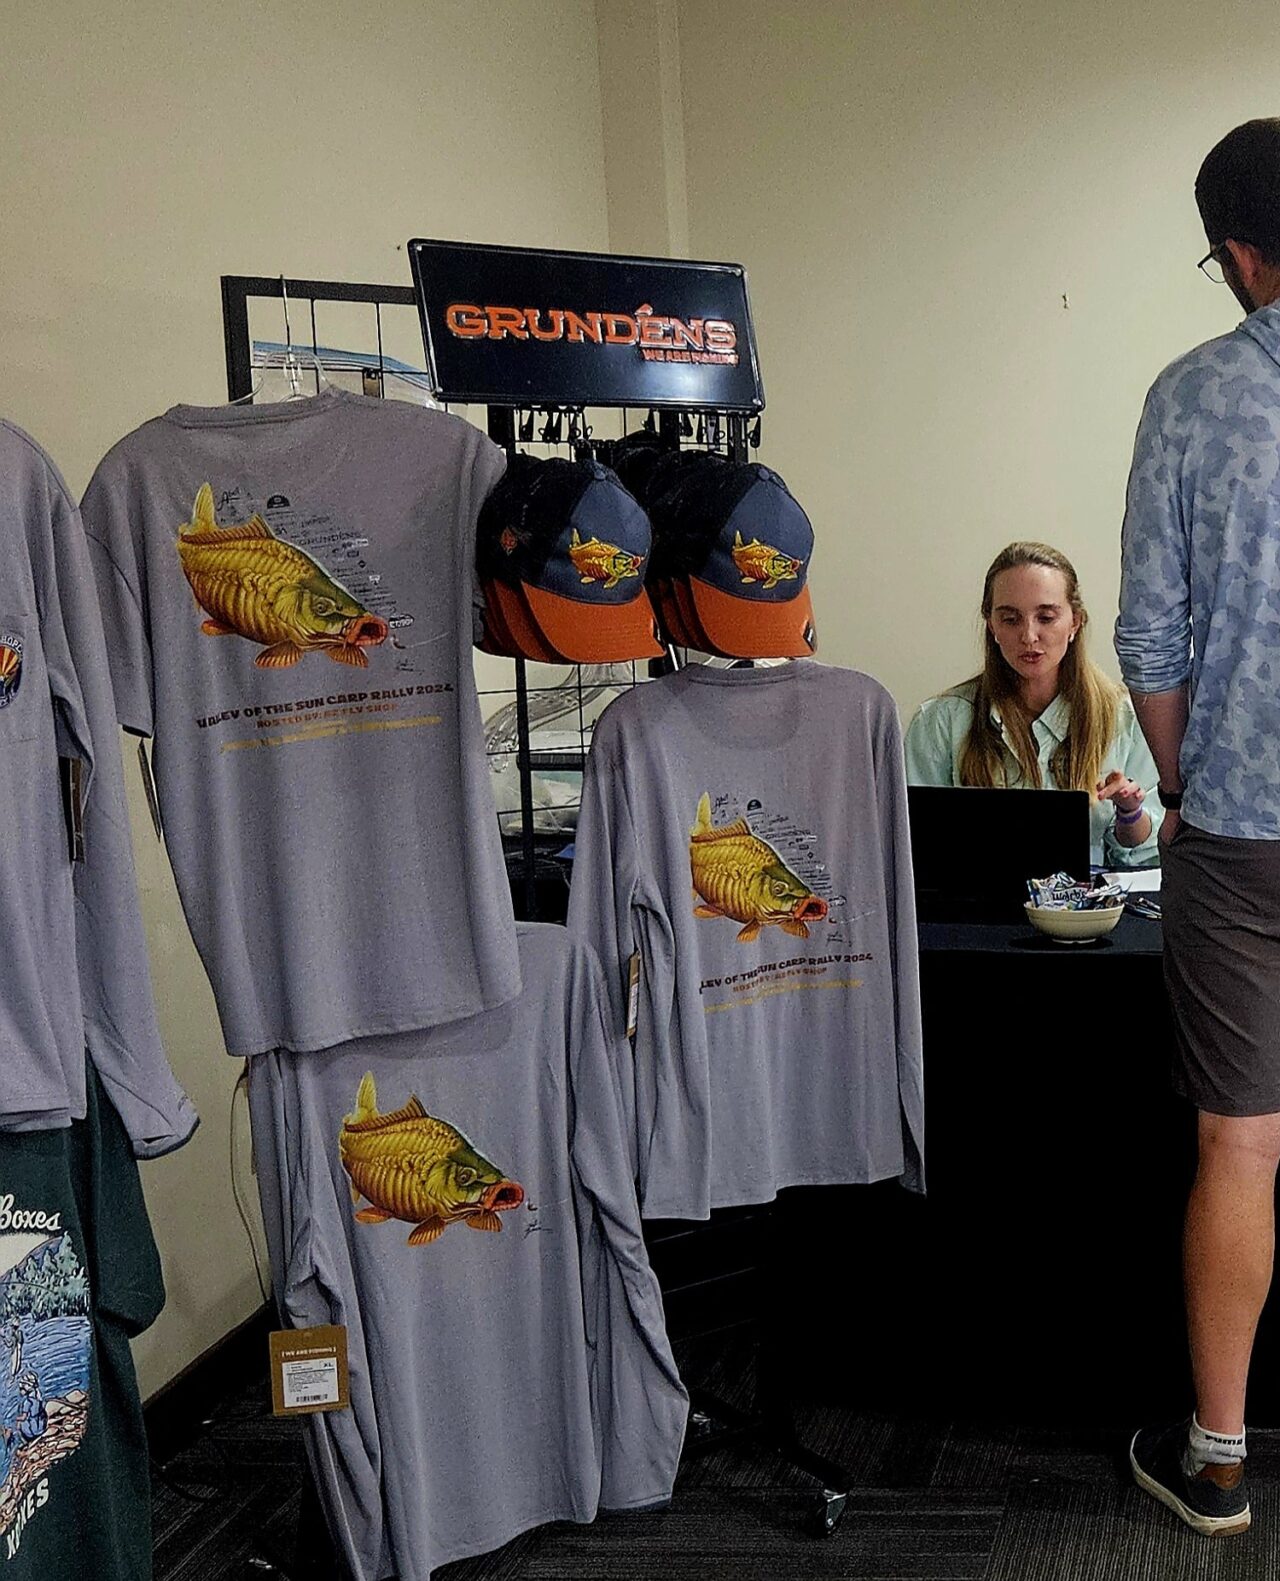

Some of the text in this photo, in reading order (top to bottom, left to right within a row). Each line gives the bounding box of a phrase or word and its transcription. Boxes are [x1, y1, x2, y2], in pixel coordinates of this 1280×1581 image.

[447, 303, 737, 350] GRUNDÉNS
[642, 349, 664, 361] WE
[665, 350, 691, 362] ARE
[243, 708, 262, 720] OF
[263, 703, 293, 715] THE
[295, 698, 325, 711] SUN
[327, 693, 368, 705] CARP
[416, 683, 455, 695] 2024
[725, 974, 739, 985] OF
[778, 957, 807, 970] CARP
[844, 953, 873, 963] 2024
[0, 1194, 61, 1230] Boxes
